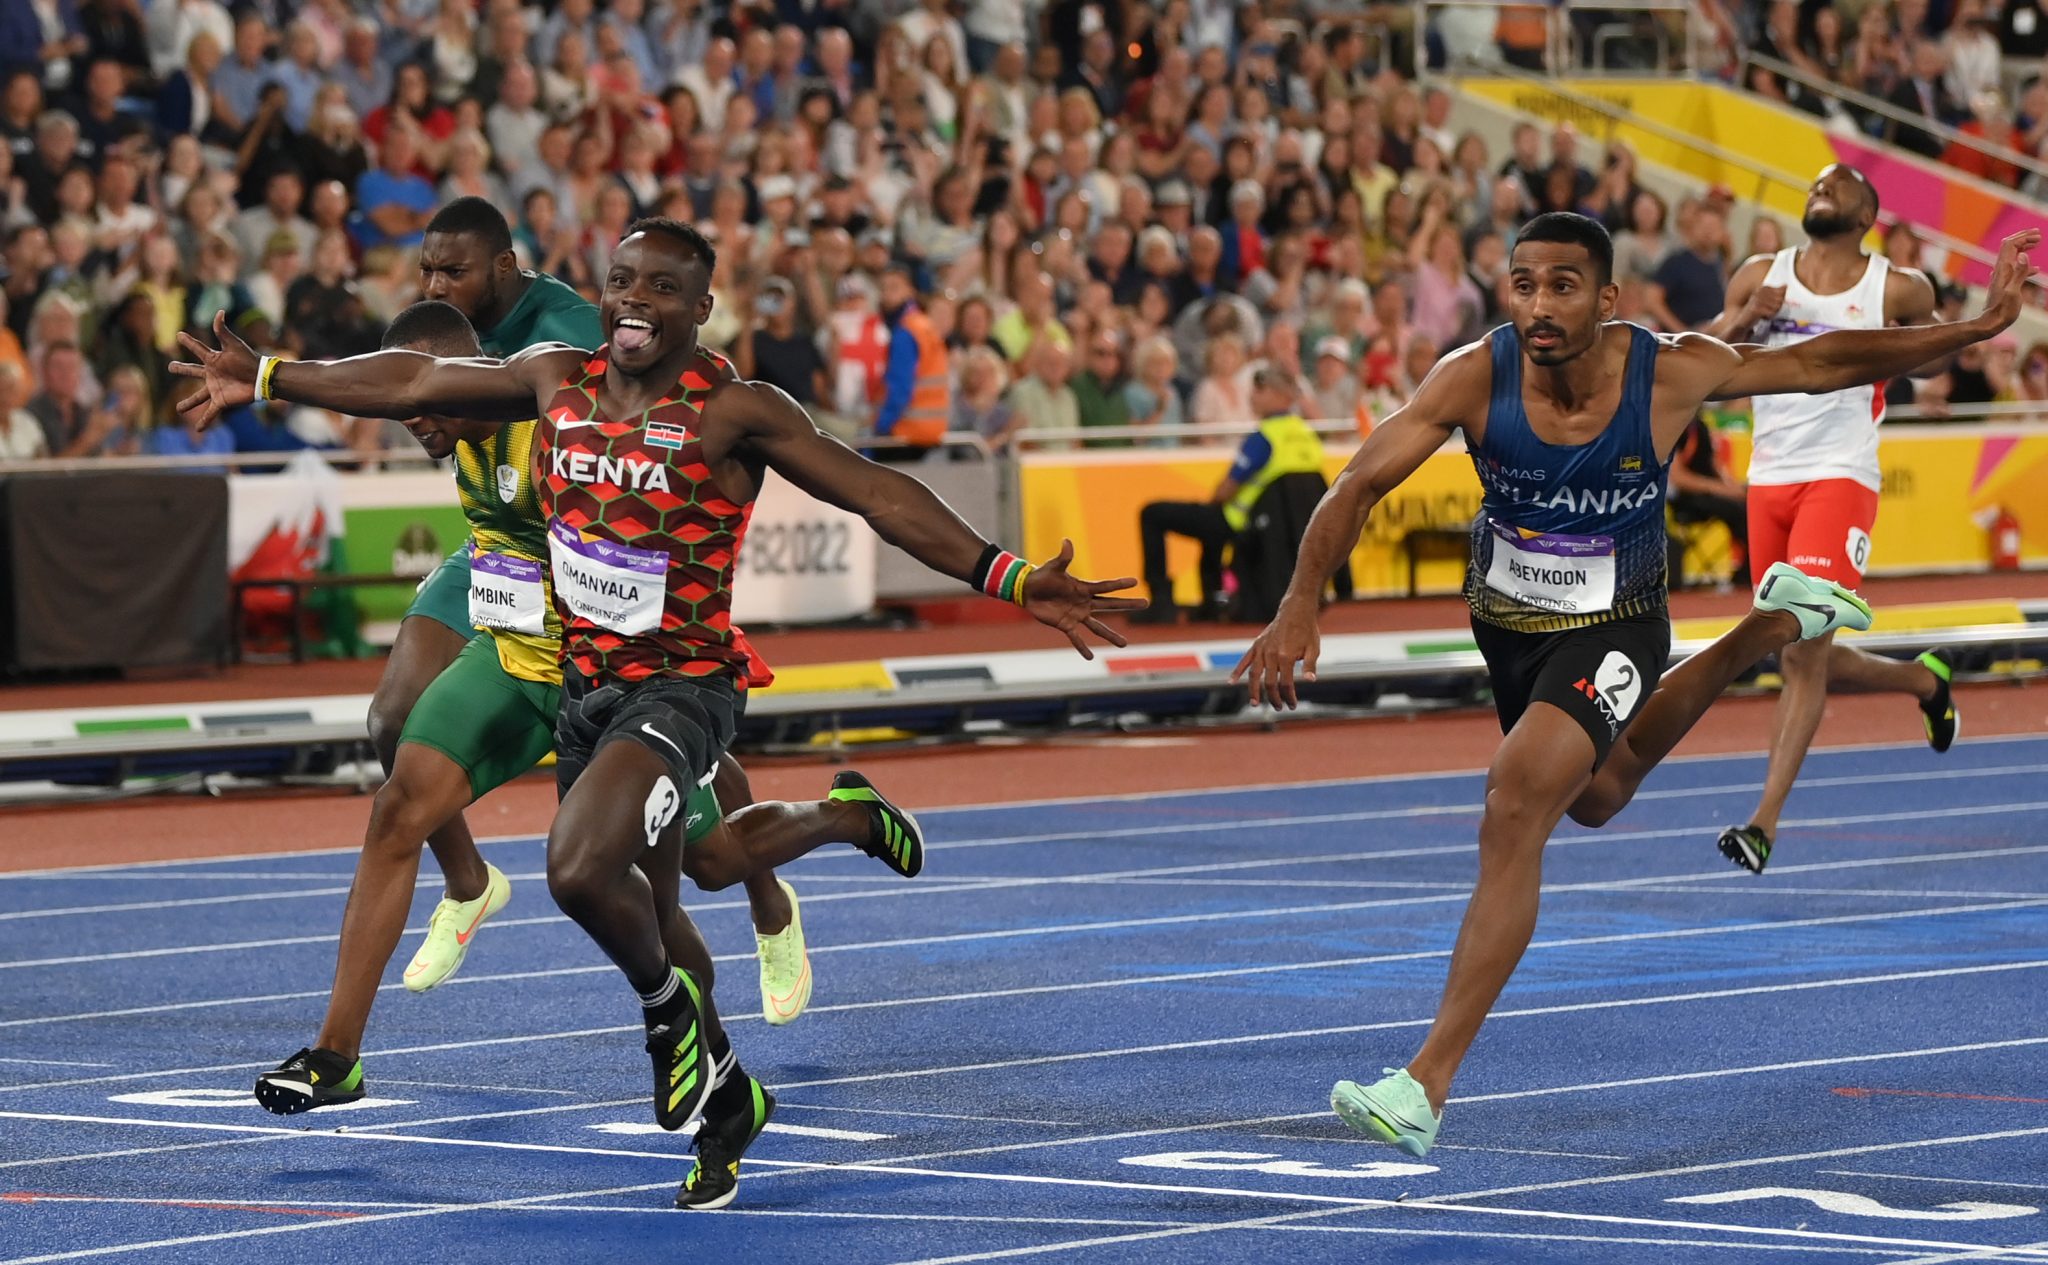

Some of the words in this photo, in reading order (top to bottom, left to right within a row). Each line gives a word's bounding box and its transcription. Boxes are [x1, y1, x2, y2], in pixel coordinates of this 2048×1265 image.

[552, 447, 671, 493] KENYA
[1501, 466, 1546, 481] MAS
[1531, 481, 1659, 514] LANKA
[736, 521, 851, 577] B2022
[1854, 536, 1866, 567] 6
[562, 561, 639, 602] OMANYALA
[1509, 558, 1587, 586] ABEYKOON
[570, 596, 628, 623] LONGINES
[1514, 591, 1578, 611] LONGINES
[1604, 664, 1634, 708] 2
[650, 789, 675, 834] 3
